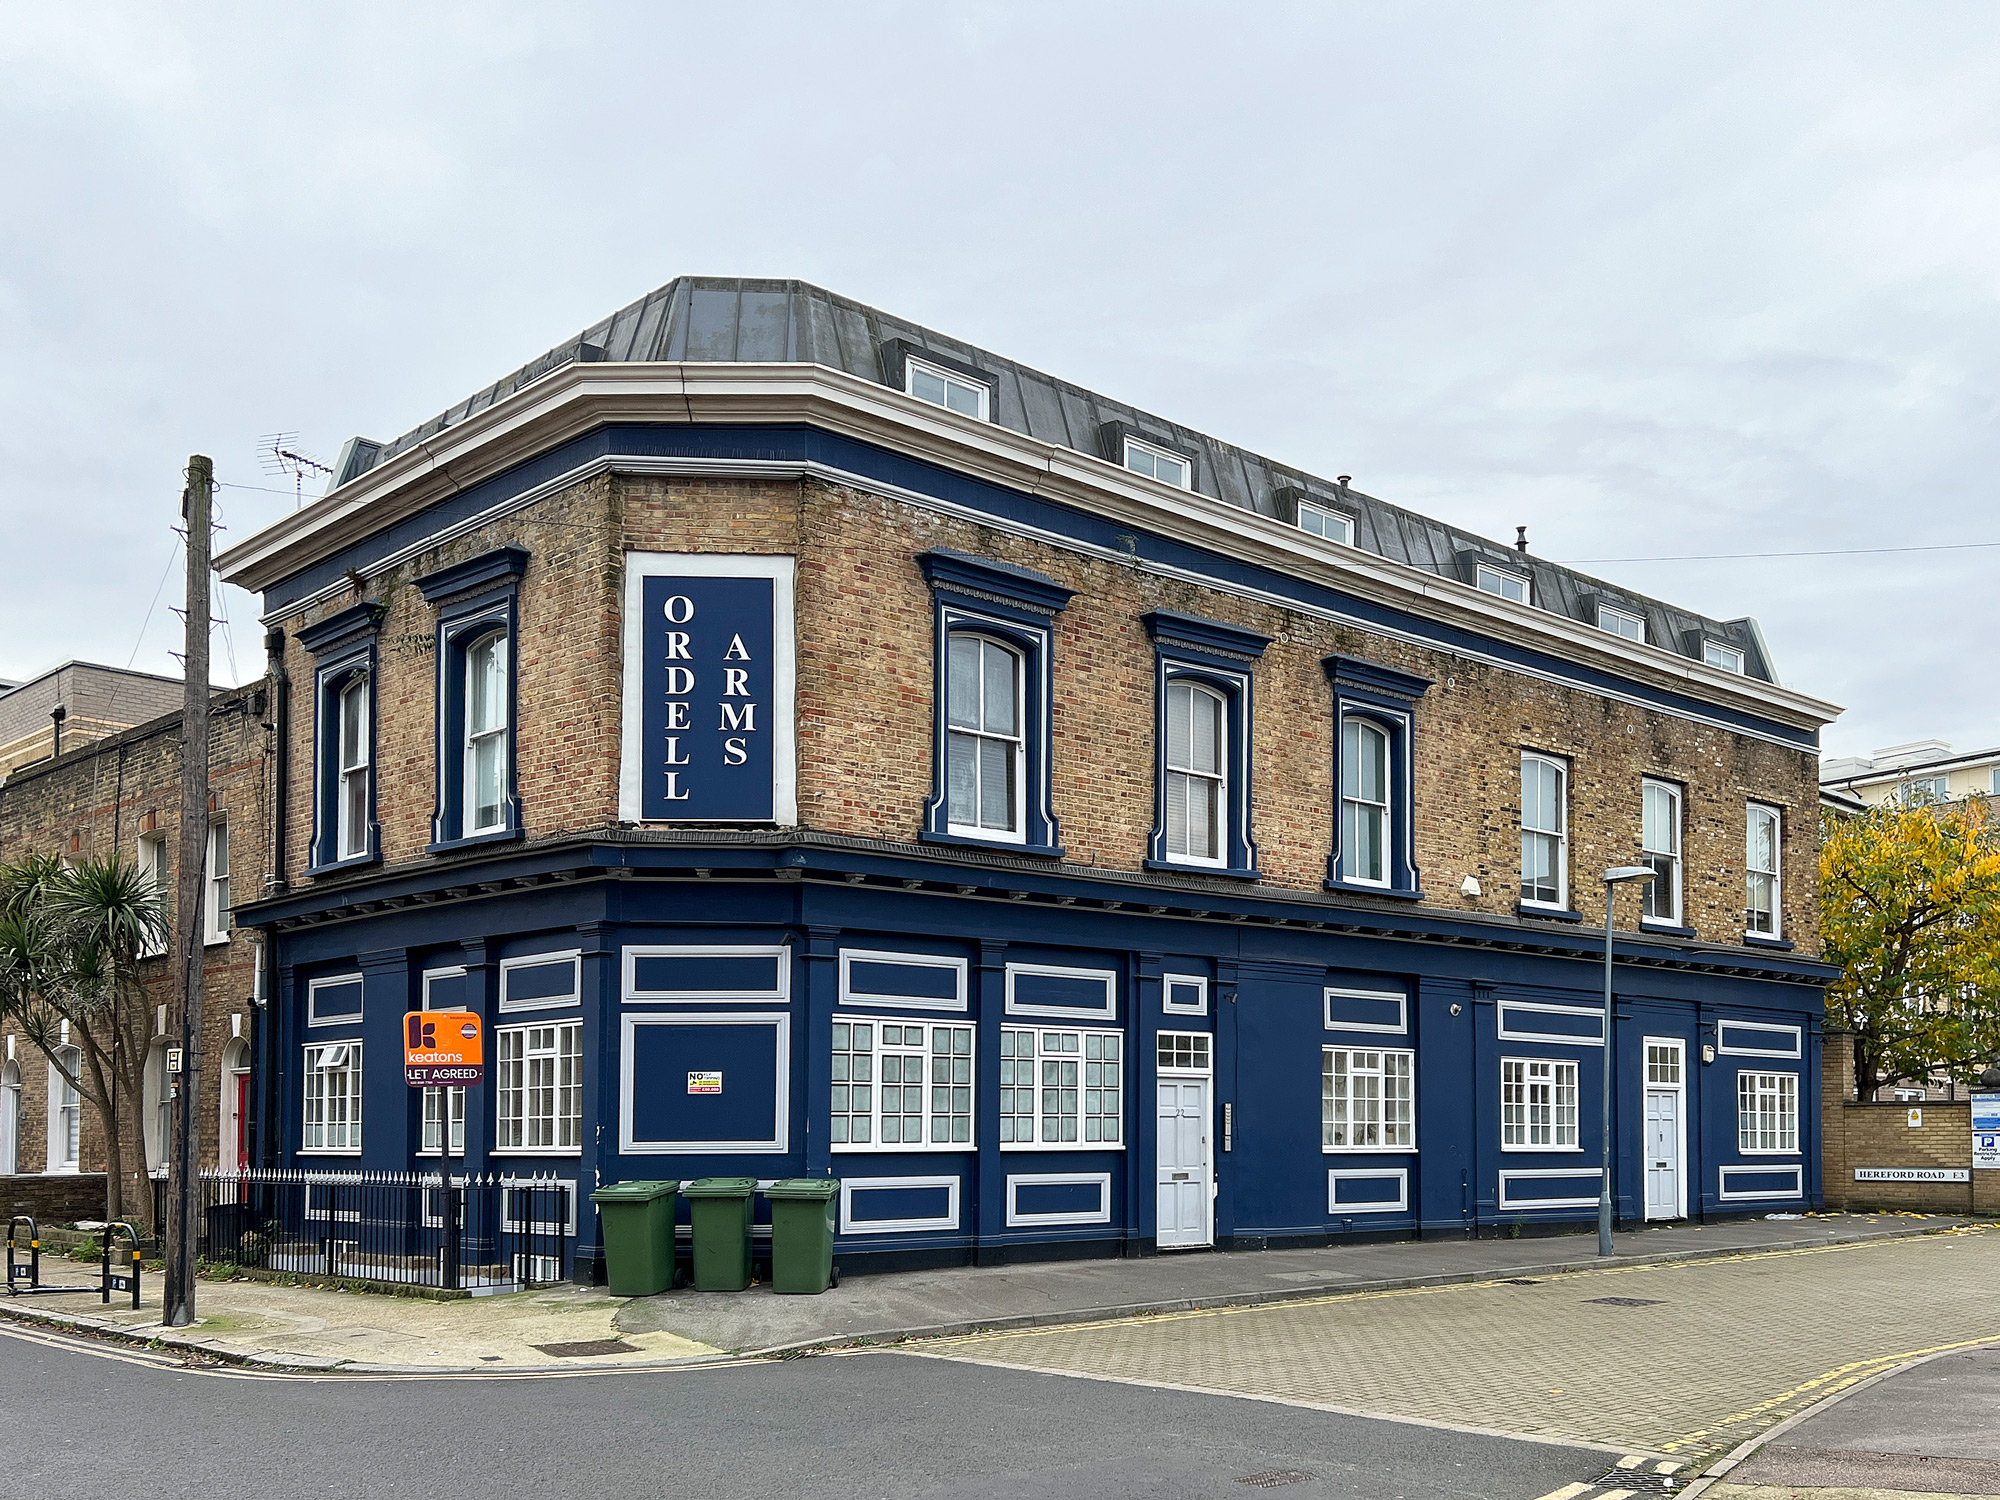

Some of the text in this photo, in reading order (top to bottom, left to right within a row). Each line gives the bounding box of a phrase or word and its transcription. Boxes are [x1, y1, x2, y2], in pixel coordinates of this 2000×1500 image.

[663, 595, 695, 800] ORDELL
[718, 632, 757, 766] ARMS
[408, 1051, 463, 1063] keatons
[431, 1068, 478, 1079] AGREED
[1176, 1108, 1184, 1116] 22
[1859, 1171, 1914, 1179] HEREFORD
[1917, 1171, 1945, 1179] ROAD
